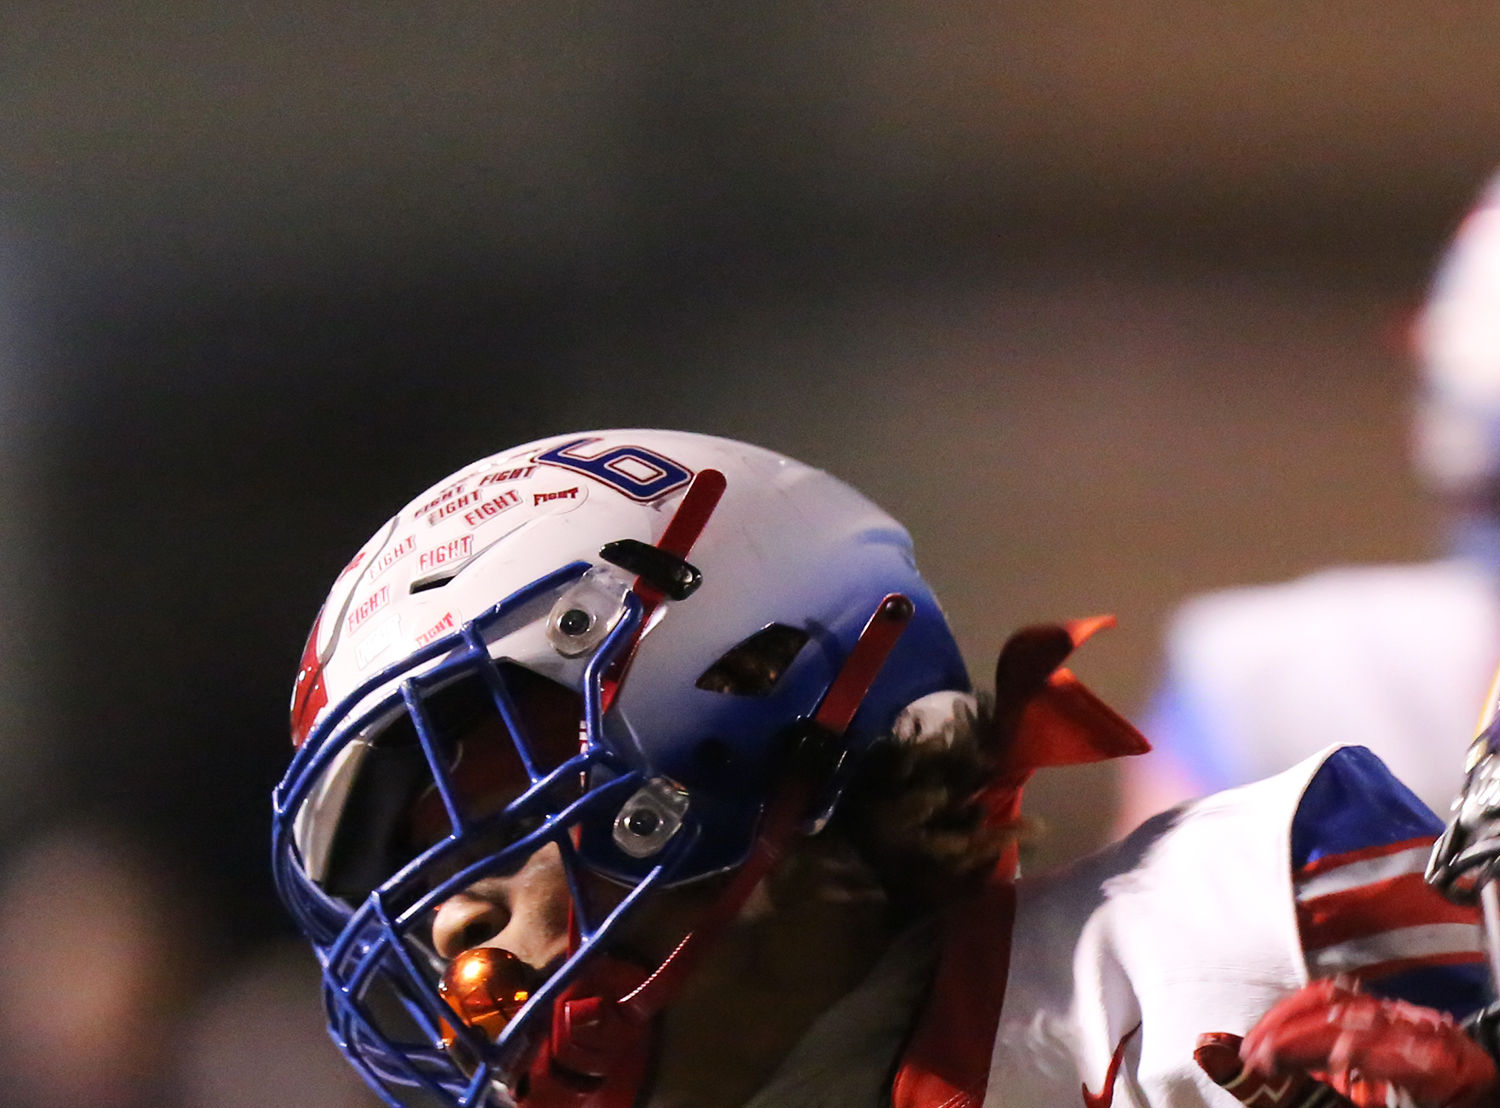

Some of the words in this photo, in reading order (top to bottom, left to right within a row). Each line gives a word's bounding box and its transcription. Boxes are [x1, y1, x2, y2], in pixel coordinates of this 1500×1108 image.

[479, 465, 537, 486] FIGHT
[529, 437, 695, 506] 6
[428, 489, 481, 526] FIGHT
[464, 489, 520, 526] FIGHT
[533, 487, 579, 507] FIGHT
[419, 535, 471, 571] FIGHT
[347, 586, 387, 632] FIGHT
[415, 612, 454, 648] FIGHT
